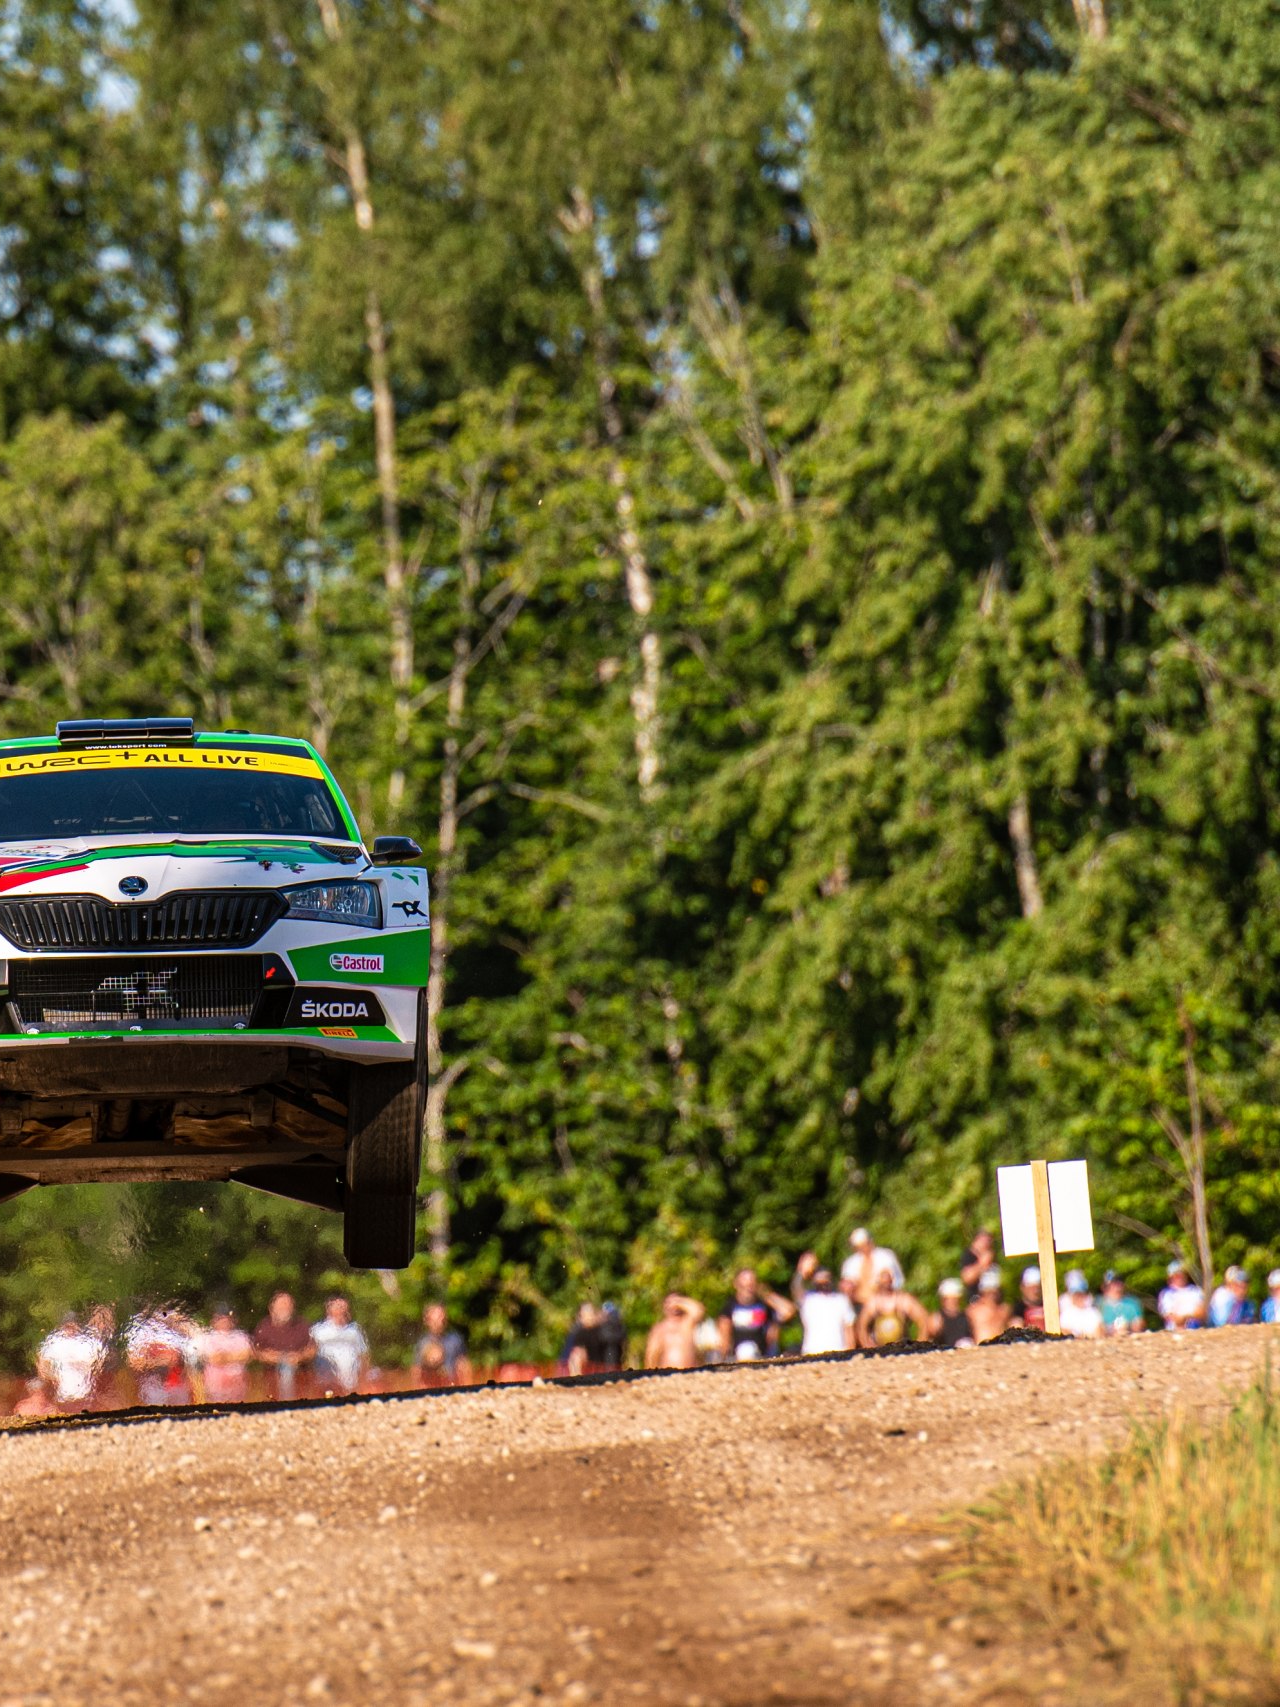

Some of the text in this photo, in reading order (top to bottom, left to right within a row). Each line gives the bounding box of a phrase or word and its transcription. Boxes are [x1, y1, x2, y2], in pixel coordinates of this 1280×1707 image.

[144, 754, 193, 763] ALL
[202, 754, 259, 766] LIVE
[343, 955, 381, 971] Castrol
[301, 999, 369, 1018] ŠKODA
